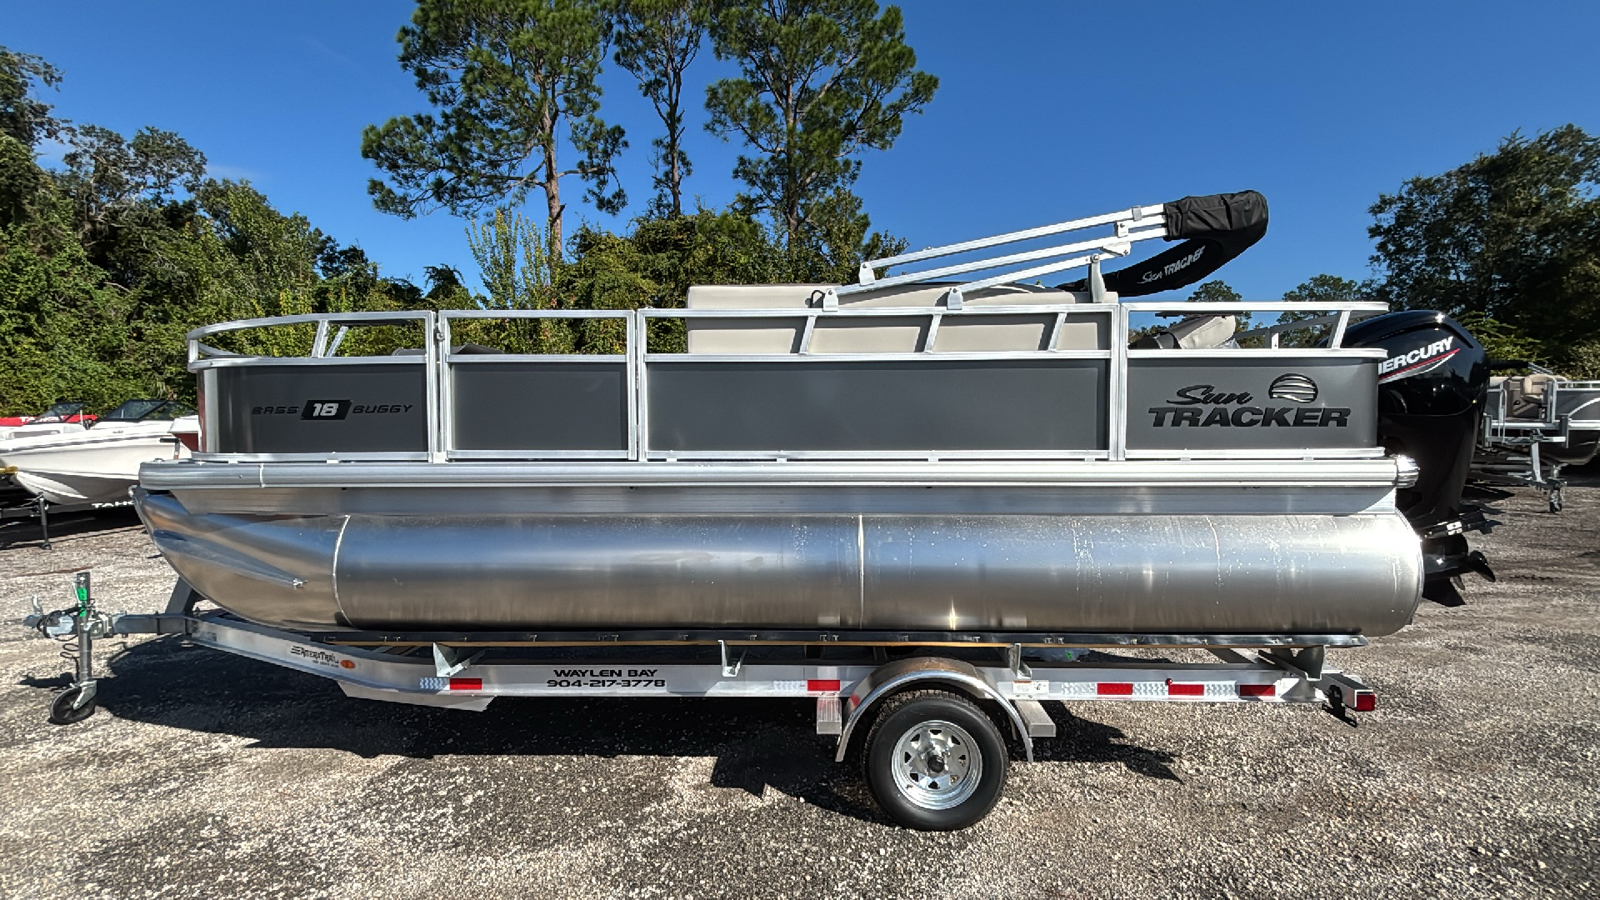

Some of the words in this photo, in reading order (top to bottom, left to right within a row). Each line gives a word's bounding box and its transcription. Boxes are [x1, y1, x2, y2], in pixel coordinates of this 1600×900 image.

[1137, 271, 1163, 284] Sun
[1166, 384, 1254, 406] Sun
[251, 406, 300, 415] BASS
[312, 402, 340, 417] 18
[352, 404, 414, 414] BUGGY
[1148, 407, 1351, 428] TRACKER
[553, 669, 622, 677] WAYLEN
[627, 669, 658, 677] BAY
[546, 679, 666, 688] 904-217-3778
